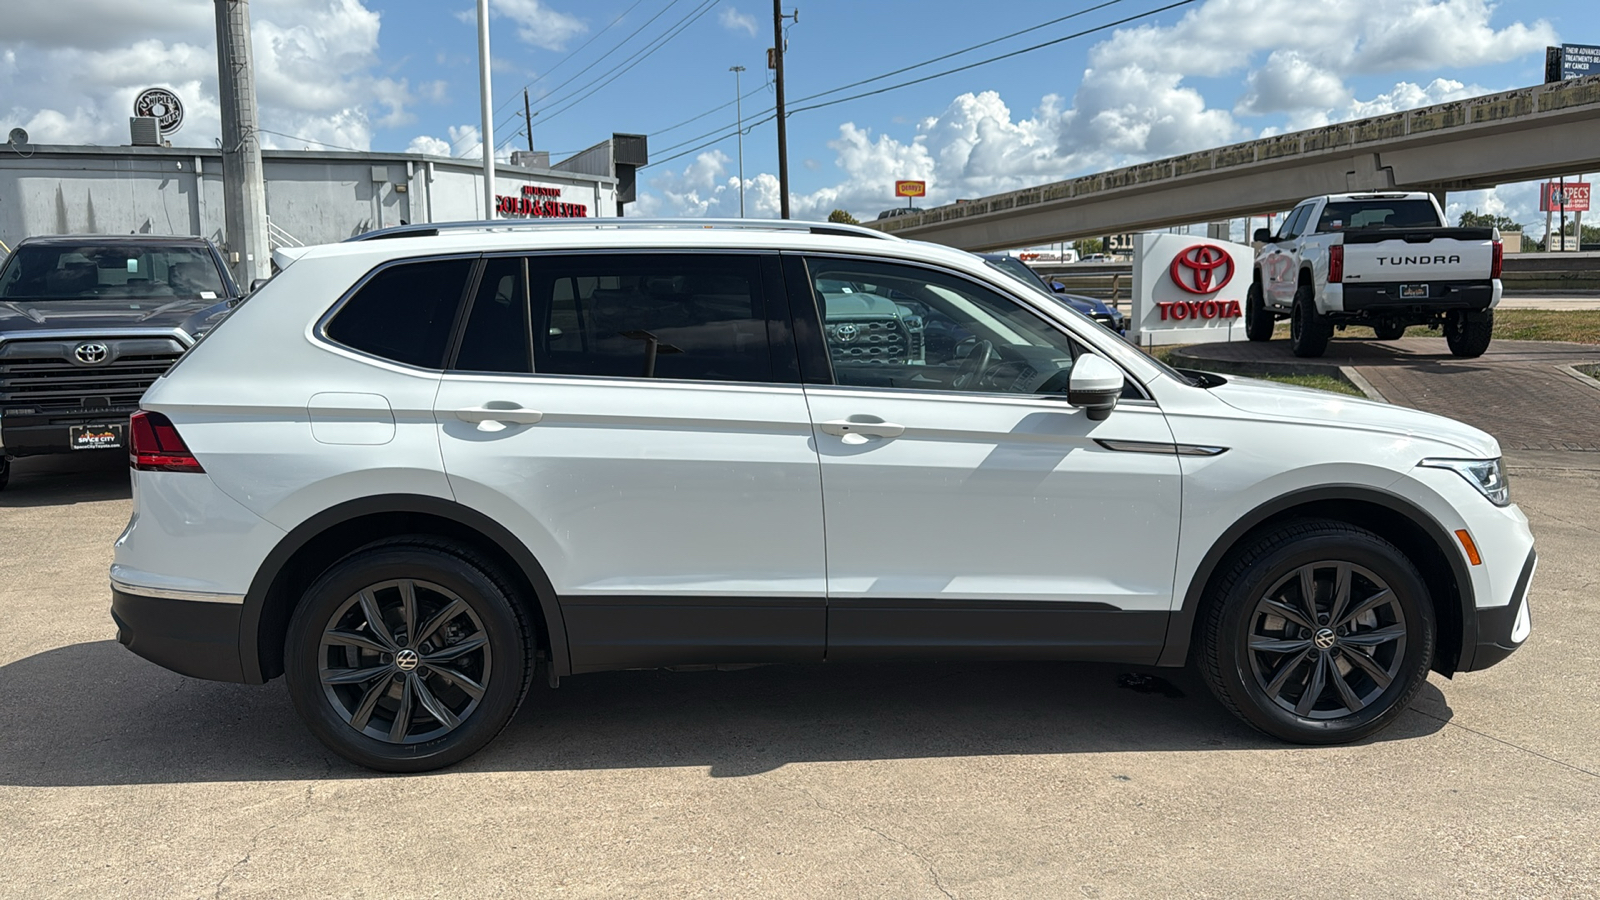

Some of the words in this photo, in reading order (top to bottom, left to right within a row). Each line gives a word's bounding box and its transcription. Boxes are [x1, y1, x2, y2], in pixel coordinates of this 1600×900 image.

[140, 95, 175, 109] SHIPLEY
[160, 111, 178, 124] NUTS
[523, 185, 561, 197] HOUSTON
[1563, 187, 1589, 199] SPEC'S
[1376, 255, 1461, 266] TUNDRA
[1156, 300, 1242, 320] TOYOTA
